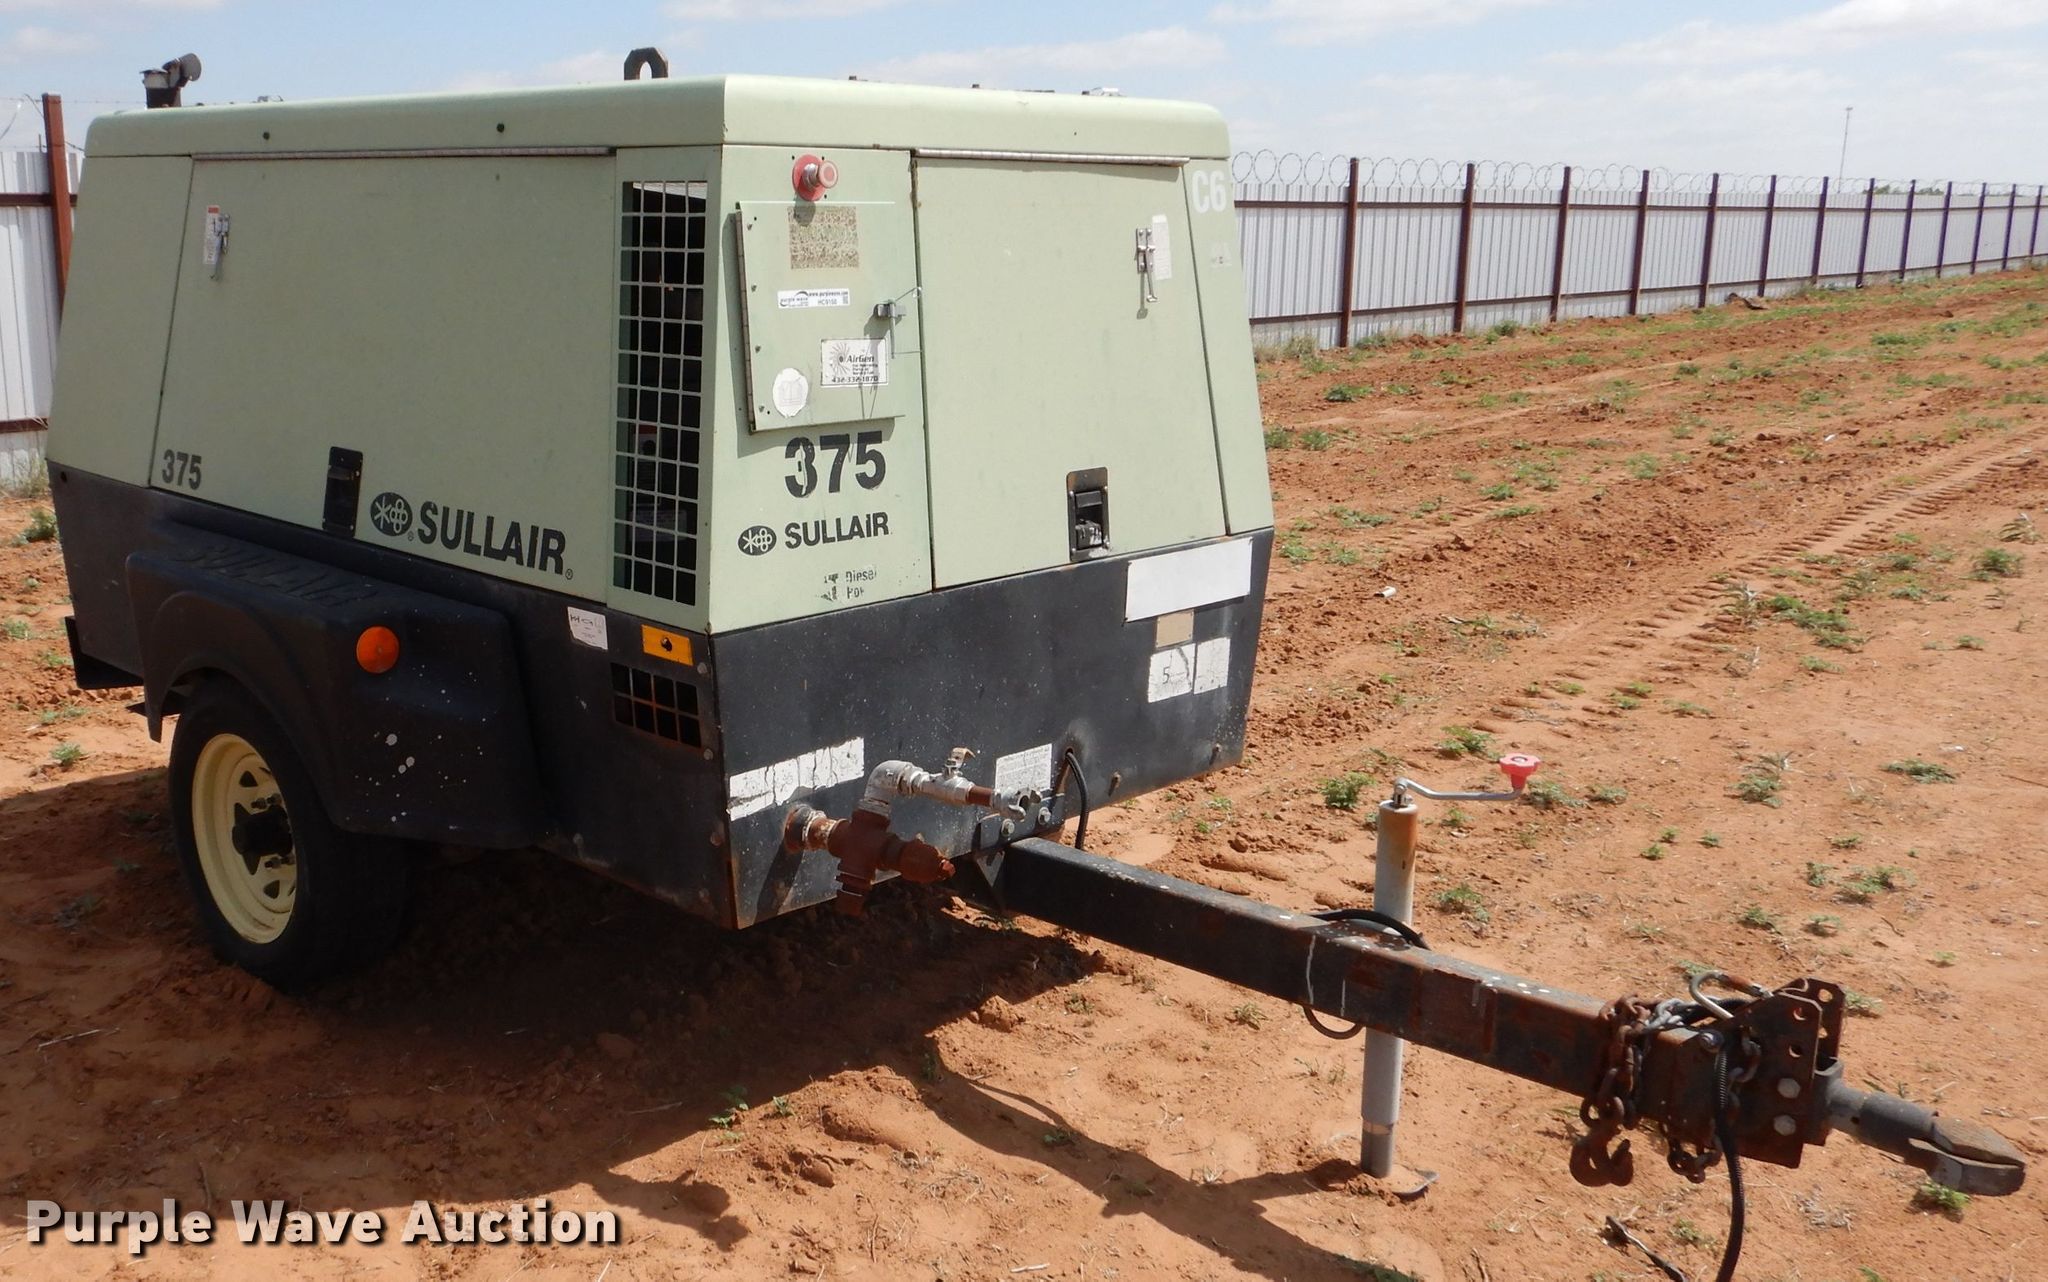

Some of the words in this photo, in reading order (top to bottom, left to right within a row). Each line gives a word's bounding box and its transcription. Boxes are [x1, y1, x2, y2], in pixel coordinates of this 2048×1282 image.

[1192, 170, 1227, 213] C6
[161, 449, 202, 490] 375
[785, 430, 886, 498] 375
[417, 500, 566, 575] SULLAIR
[785, 512, 890, 549] SULLAIR
